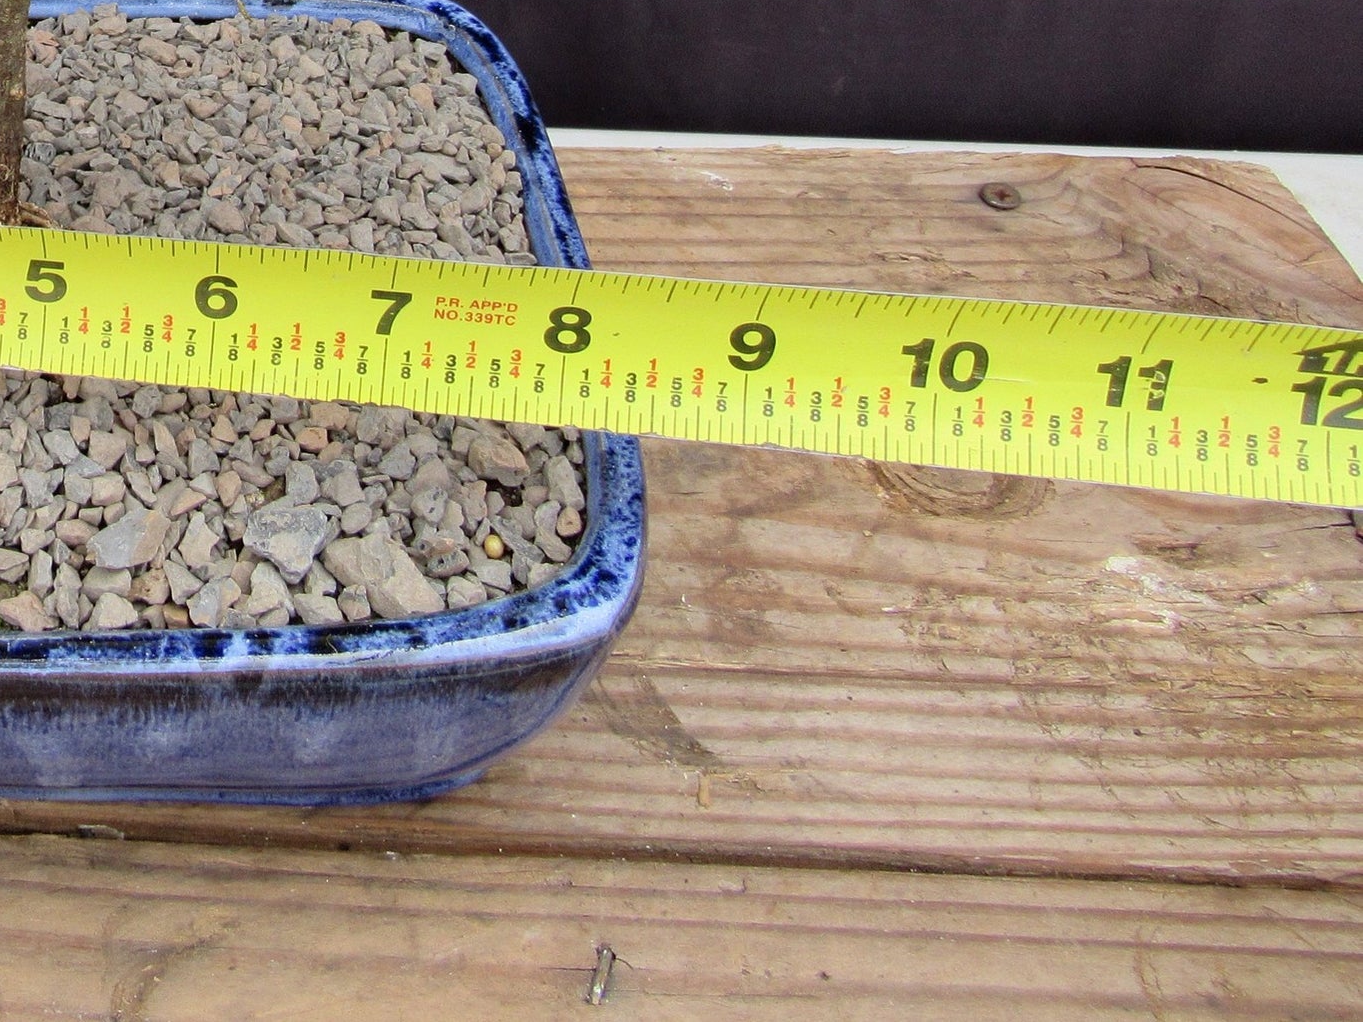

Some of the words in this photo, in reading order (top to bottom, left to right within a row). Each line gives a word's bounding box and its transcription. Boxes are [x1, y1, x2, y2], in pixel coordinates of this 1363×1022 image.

[24, 259, 67, 303] 5
[194, 275, 238, 320] 6
[370, 290, 413, 335] 7
[435, 296, 464, 309] P.R.
[469, 299, 519, 313] APP'D
[543, 306, 592, 354] 8
[727, 322, 777, 371] 9
[901, 338, 990, 392] 10
[1097, 356, 1174, 411] 11
